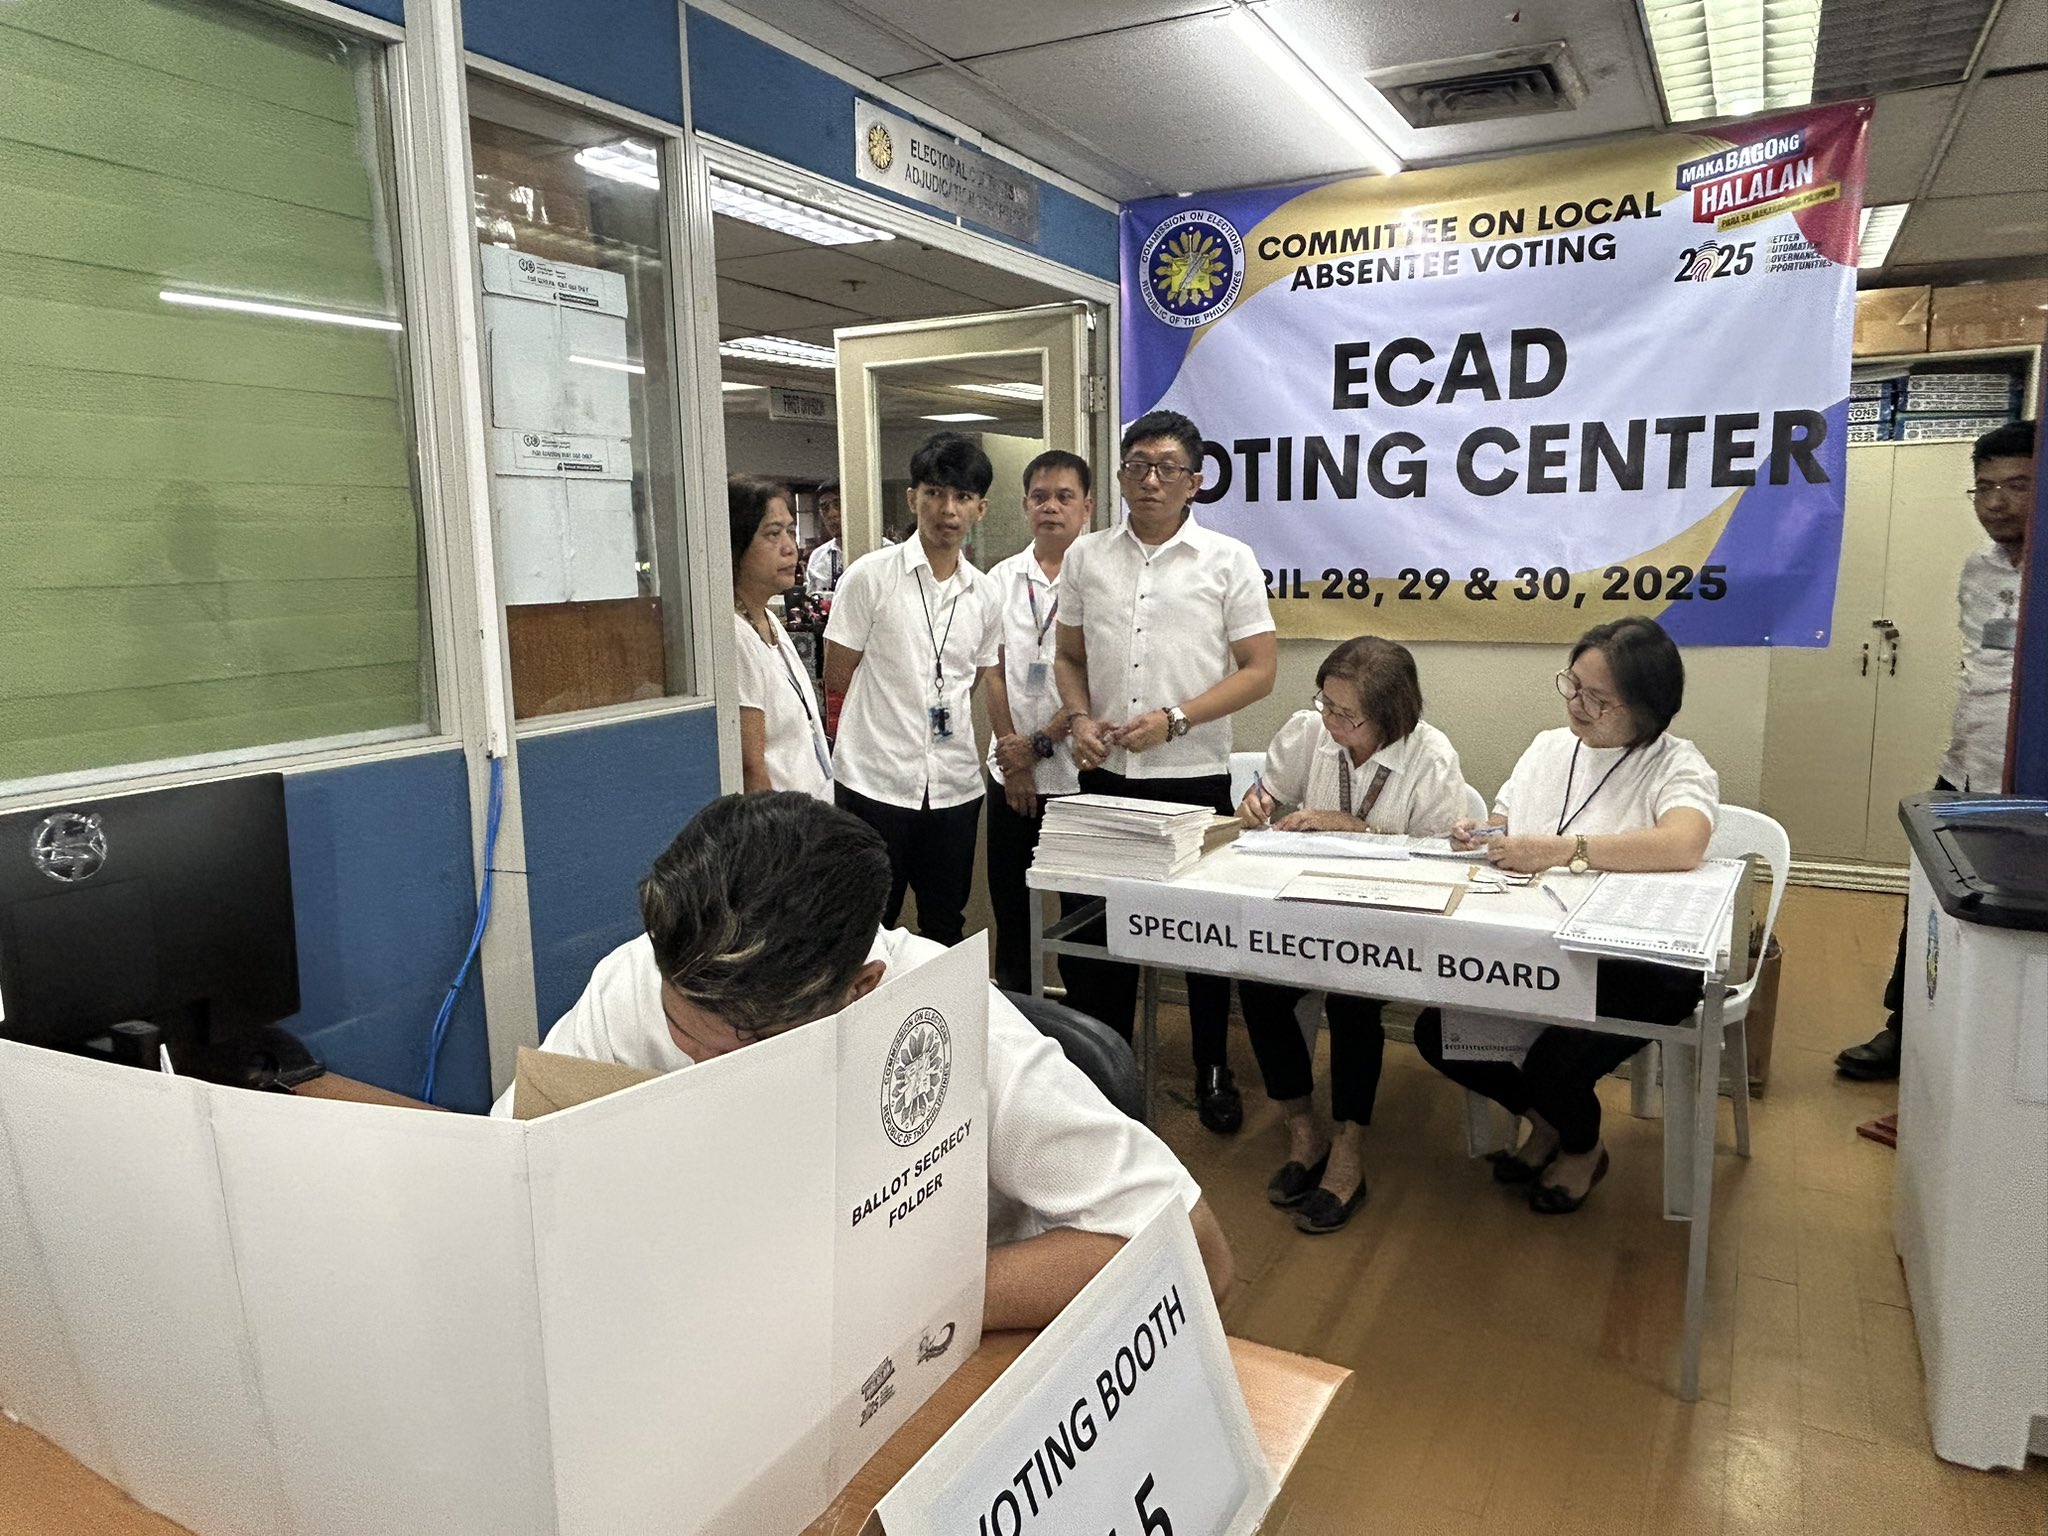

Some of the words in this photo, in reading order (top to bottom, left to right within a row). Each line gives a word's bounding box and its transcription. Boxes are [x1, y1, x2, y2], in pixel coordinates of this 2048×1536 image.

[1682, 134, 1800, 184] MAKABAGONG
[1701, 157, 1814, 216] HALALAN
[1142, 214, 1186, 263] COMMISSION
[1190, 212, 1204, 220] ON
[1206, 214, 1242, 255] ELECTIONS
[1258, 216, 1457, 261] COMMITTEE
[1468, 208, 1524, 238] ON
[1537, 191, 1662, 231] LOCAL
[1290, 250, 1459, 291] ABSENTEE
[1471, 232, 1617, 273] VOTING
[1142, 280, 1168, 319] REPUBLIC
[1169, 315, 1180, 325] OF
[1183, 316, 1200, 326] THE
[1204, 270, 1242, 321] PHILIPPINES
[1332, 327, 1567, 410] ECAD
[1194, 430, 1428, 504] OTING
[1455, 408, 1831, 497] CENTER
[1262, 568, 1309, 600] RIL
[1321, 568, 1384, 607] 28,
[1398, 568, 1451, 600] 29
[1464, 567, 1499, 600] &
[1513, 566, 1586, 608] 30,
[1602, 565, 1728, 600] 2025
[1128, 913, 1239, 949] SPECIAL
[1249, 929, 1422, 974] ELECTORAL
[1437, 953, 1561, 992] BOARD
[883, 1104, 904, 1144] REPUBLIC
[903, 1133, 913, 1144] OF
[852, 1167, 911, 1227] BALLOT
[914, 1118, 972, 1178] SECRECY
[889, 1172, 943, 1229] FOLDER
[979, 1397, 1098, 1536] OTING
[1096, 1284, 1186, 1422] BOOTH
